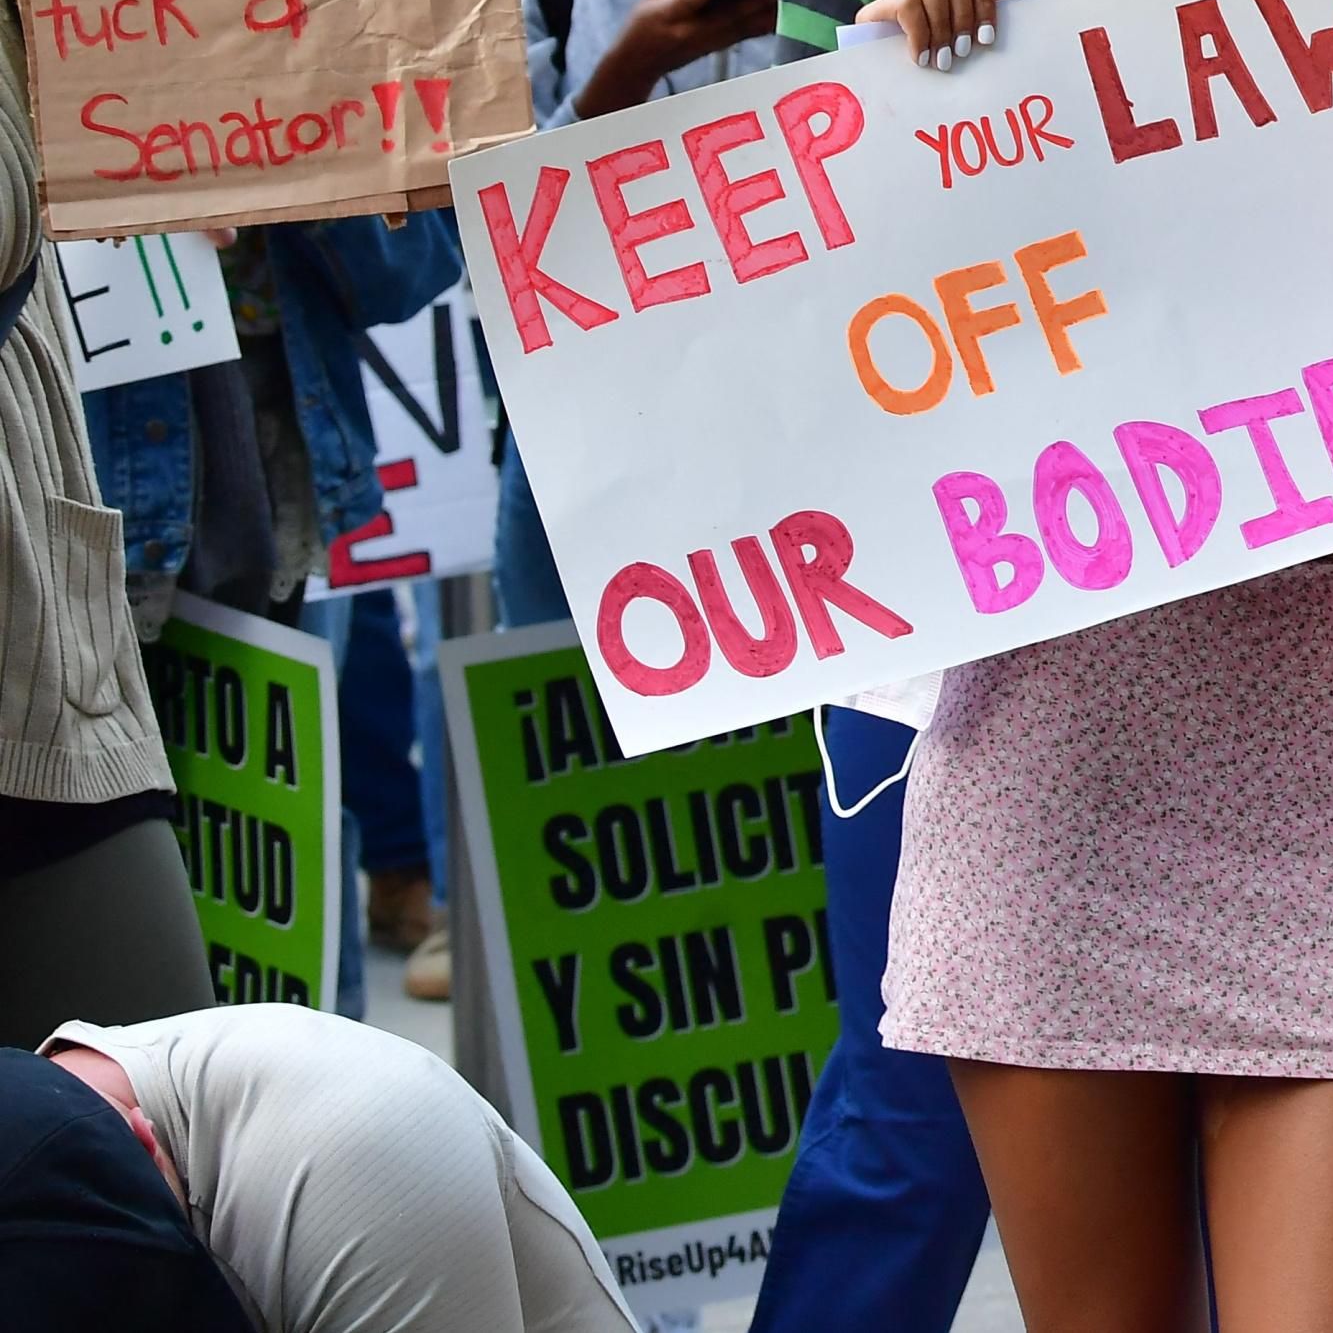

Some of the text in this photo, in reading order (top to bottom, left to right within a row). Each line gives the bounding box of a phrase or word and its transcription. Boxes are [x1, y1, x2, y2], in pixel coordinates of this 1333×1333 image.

[476, 78, 867, 354] KEEP
[915, 94, 1076, 190] YOUR
[846, 229, 1108, 417] OFF
[597, 508, 914, 698] OUR
[265, 680, 299, 791] A
[531, 952, 582, 1054] Y
[608, 924, 747, 1042] SIN
